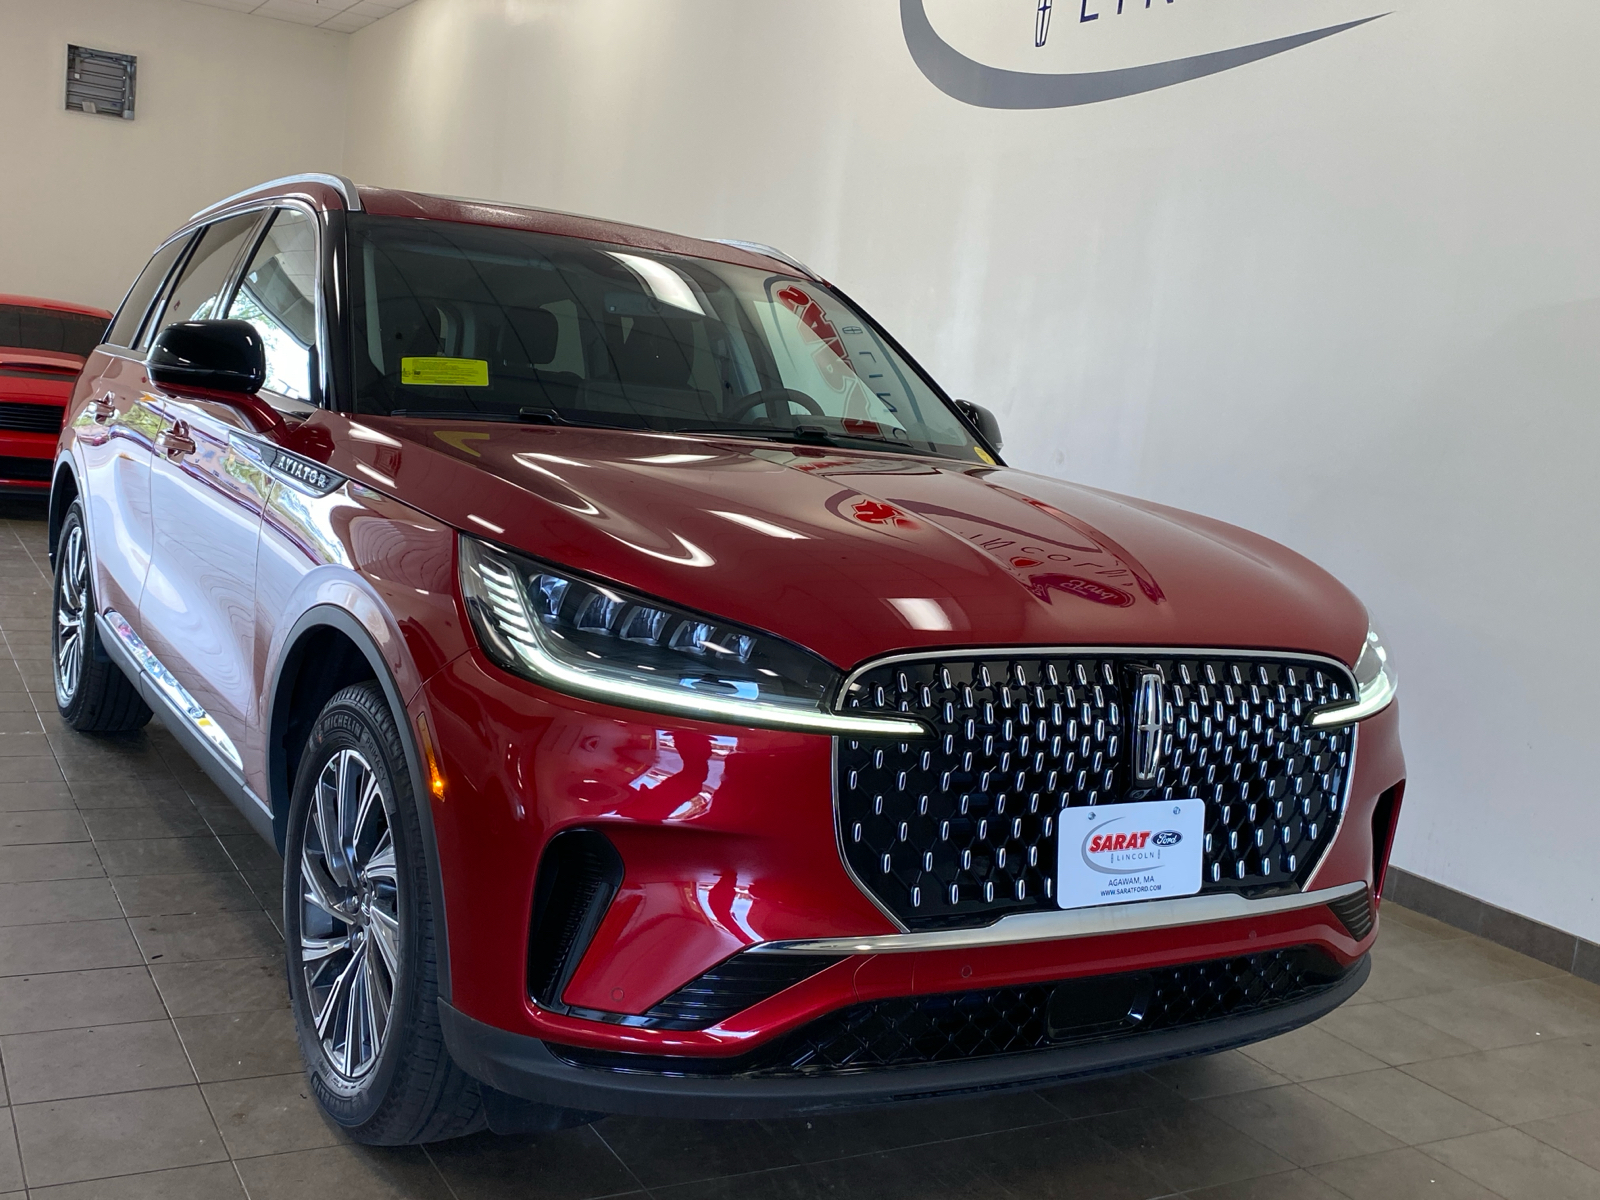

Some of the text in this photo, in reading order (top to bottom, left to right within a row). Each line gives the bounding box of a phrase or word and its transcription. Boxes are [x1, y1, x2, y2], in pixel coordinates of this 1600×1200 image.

[277, 455, 327, 488] AVIATOR
[323, 714, 362, 738] MICHELIN
[366, 738, 387, 781] PRIMACY
[1088, 831, 1178, 853] SARAT Ford
[1116, 852, 1155, 861] LINCOLN
[1100, 885, 1162, 896] WWW.SARATFORD.COM
[1108, 875, 1155, 887] AGAWAM, MA
